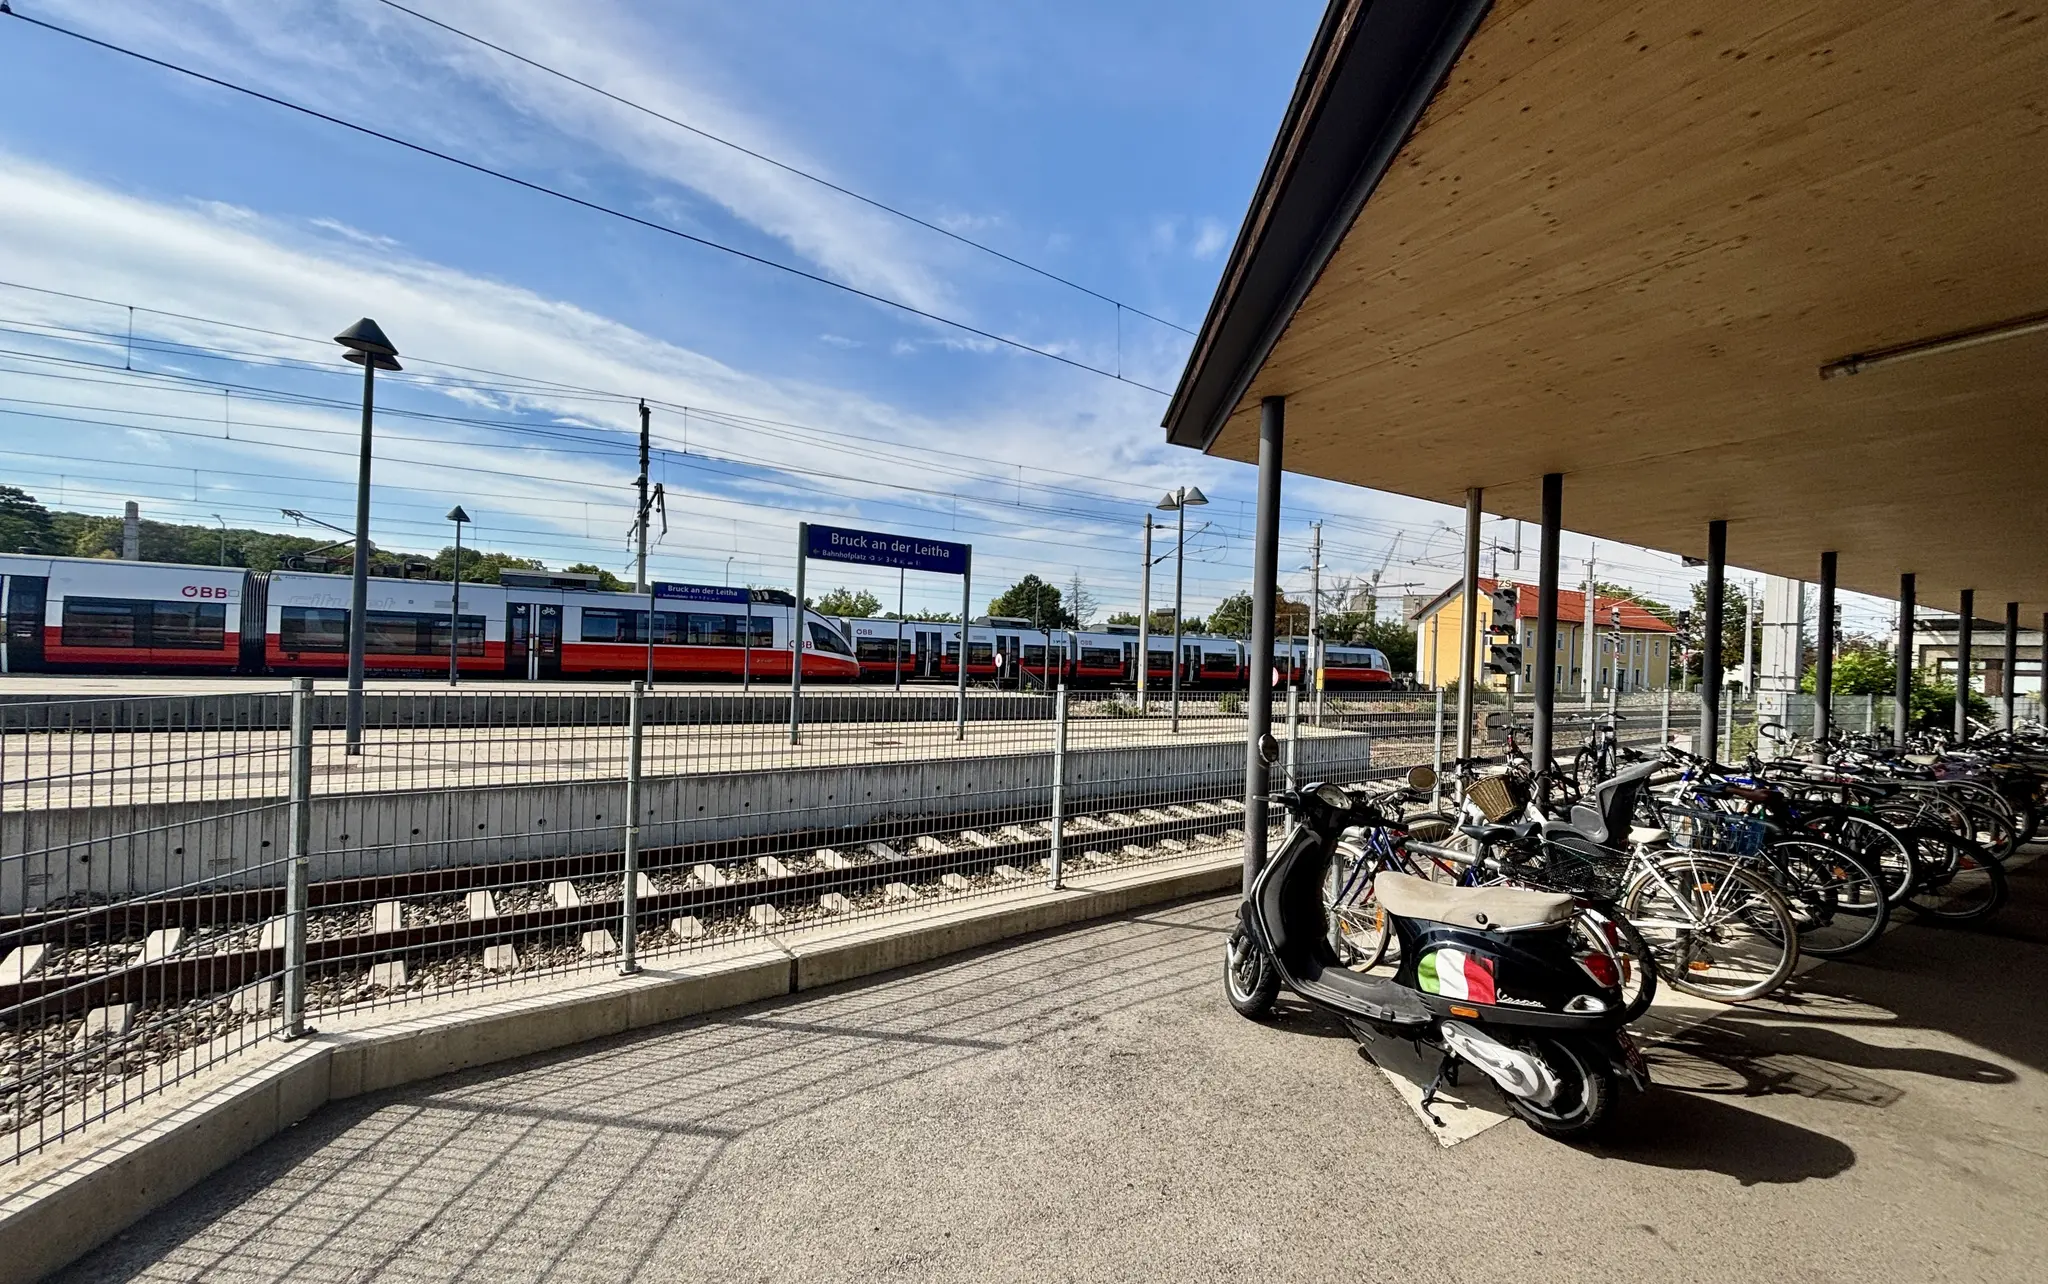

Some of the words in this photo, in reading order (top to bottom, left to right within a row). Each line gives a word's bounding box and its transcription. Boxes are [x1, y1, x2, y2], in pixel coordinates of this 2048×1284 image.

[831, 532, 868, 549] Bruck
[871, 540, 888, 551] an
[891, 540, 911, 553] der
[915, 543, 950, 558] Leitha
[822, 549, 867, 561] Bahnhofplatz
[667, 585, 689, 593] Bruck
[716, 589, 738, 597] Leitha
